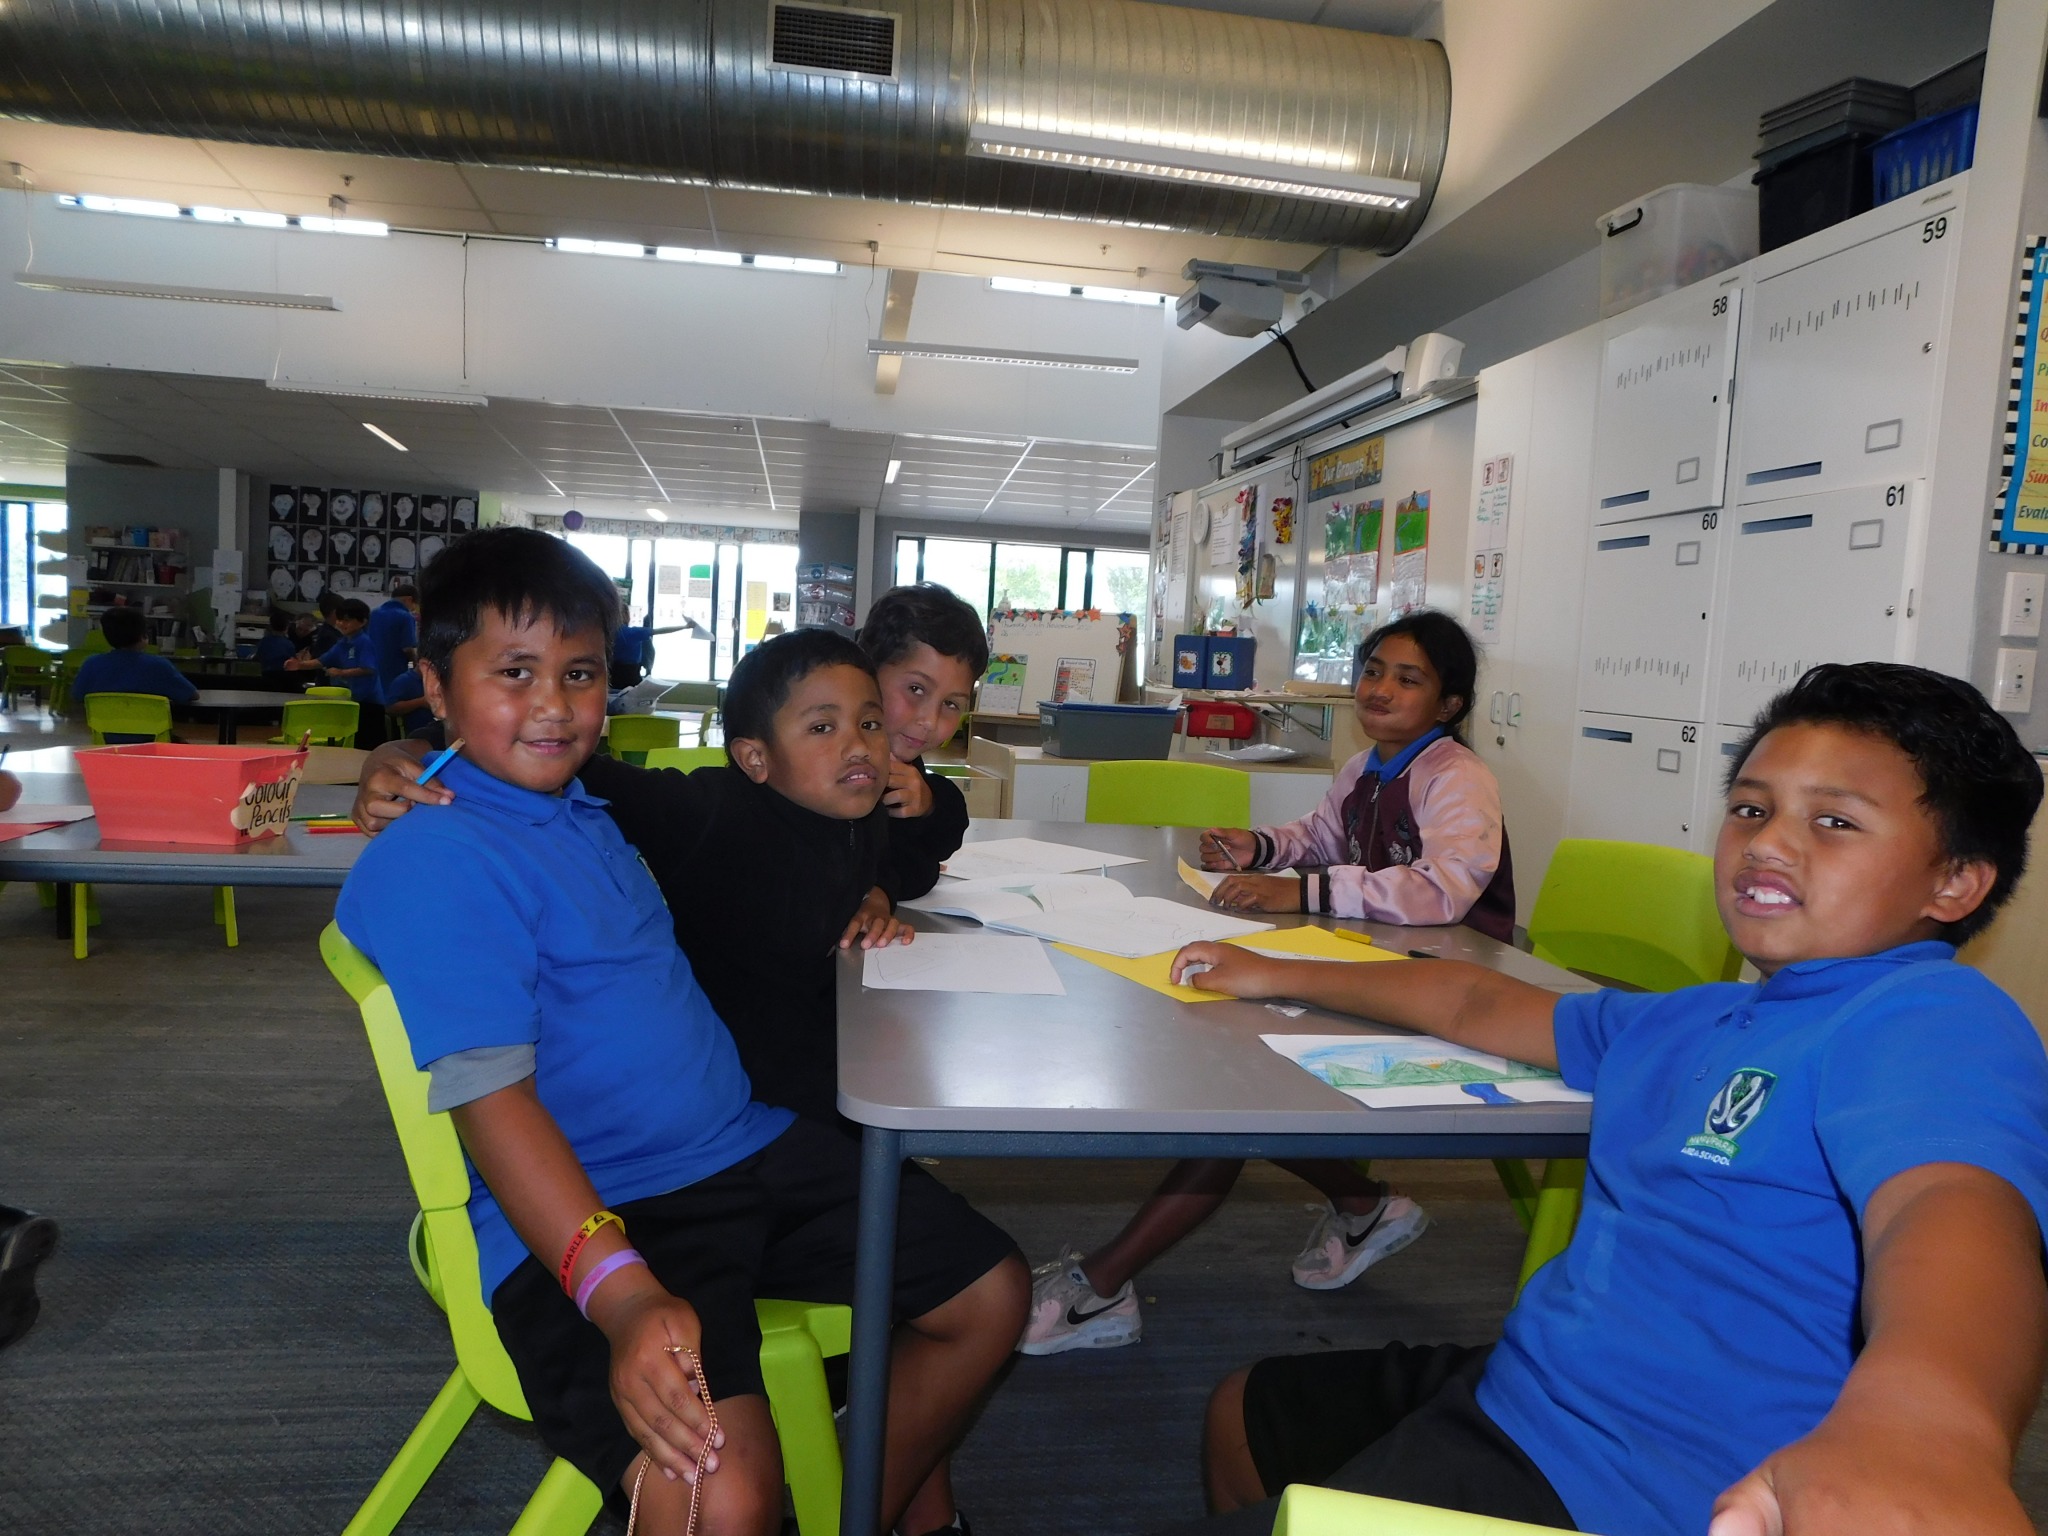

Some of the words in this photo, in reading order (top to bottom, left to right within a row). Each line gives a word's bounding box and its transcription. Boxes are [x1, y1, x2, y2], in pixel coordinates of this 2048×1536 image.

[1921, 216, 1948, 244] 59
[1711, 295, 1729, 317] 58
[1885, 484, 1906, 507] 61
[1701, 512, 1718, 531] 60
[1681, 725, 1696, 743] 62
[249, 800, 291, 830] Pencils
[1699, 1150, 1730, 1166] SCHOOL
[563, 1224, 591, 1271] MARLEY
